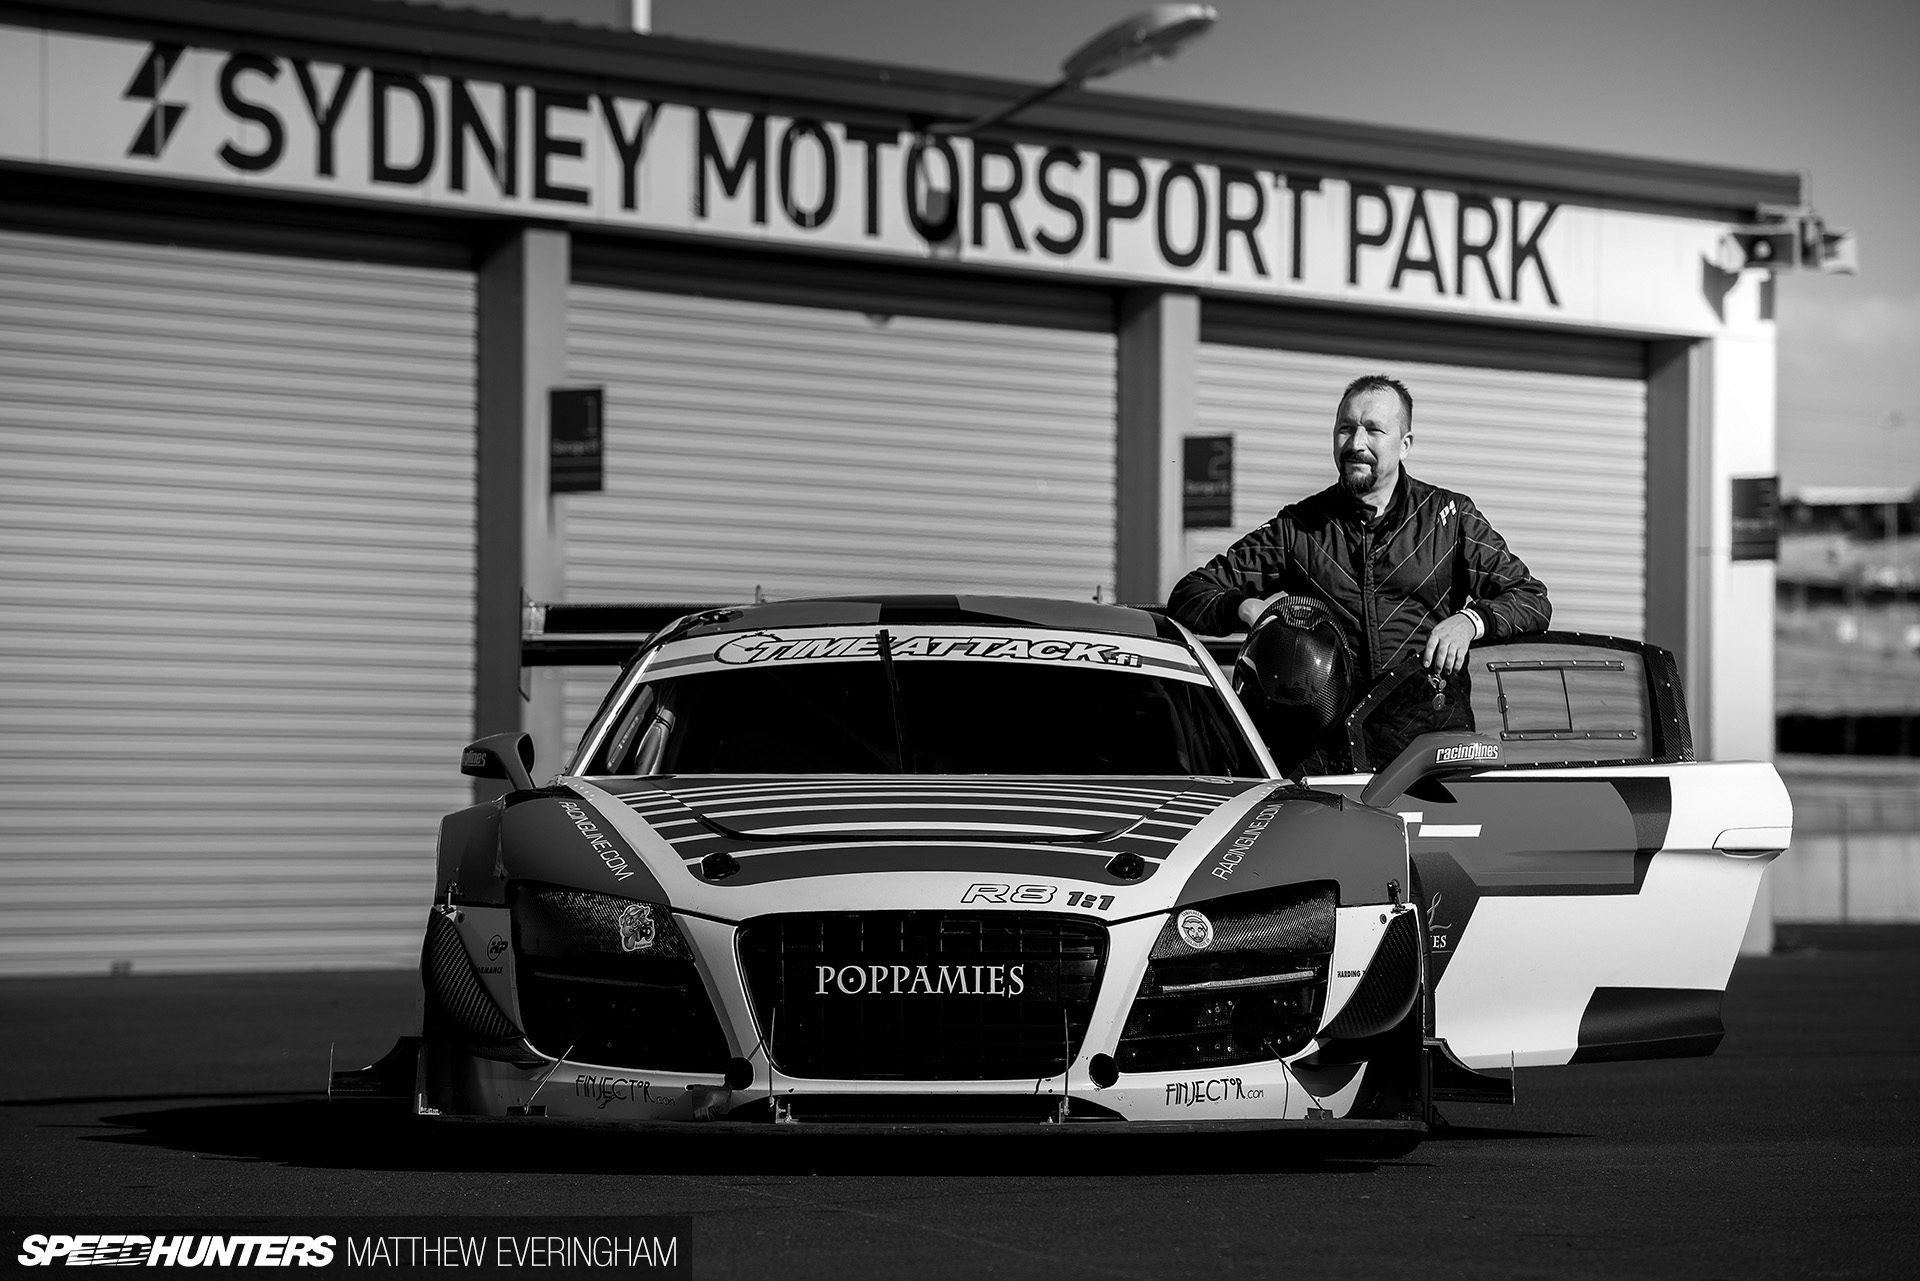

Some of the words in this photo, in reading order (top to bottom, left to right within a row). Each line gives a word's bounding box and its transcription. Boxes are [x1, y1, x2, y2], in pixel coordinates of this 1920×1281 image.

[217, 51, 666, 212] SYDNEY
[694, 108, 1322, 280] MOTORSPORT
[1350, 183, 1562, 307] PARK
[1435, 742, 1499, 764] racinglines
[558, 801, 635, 881] RACINGLINE.COM
[1211, 803, 1285, 881] RACINGLINE.COM
[960, 883, 1058, 904] R8
[815, 963, 1025, 998] POPPAMIES
